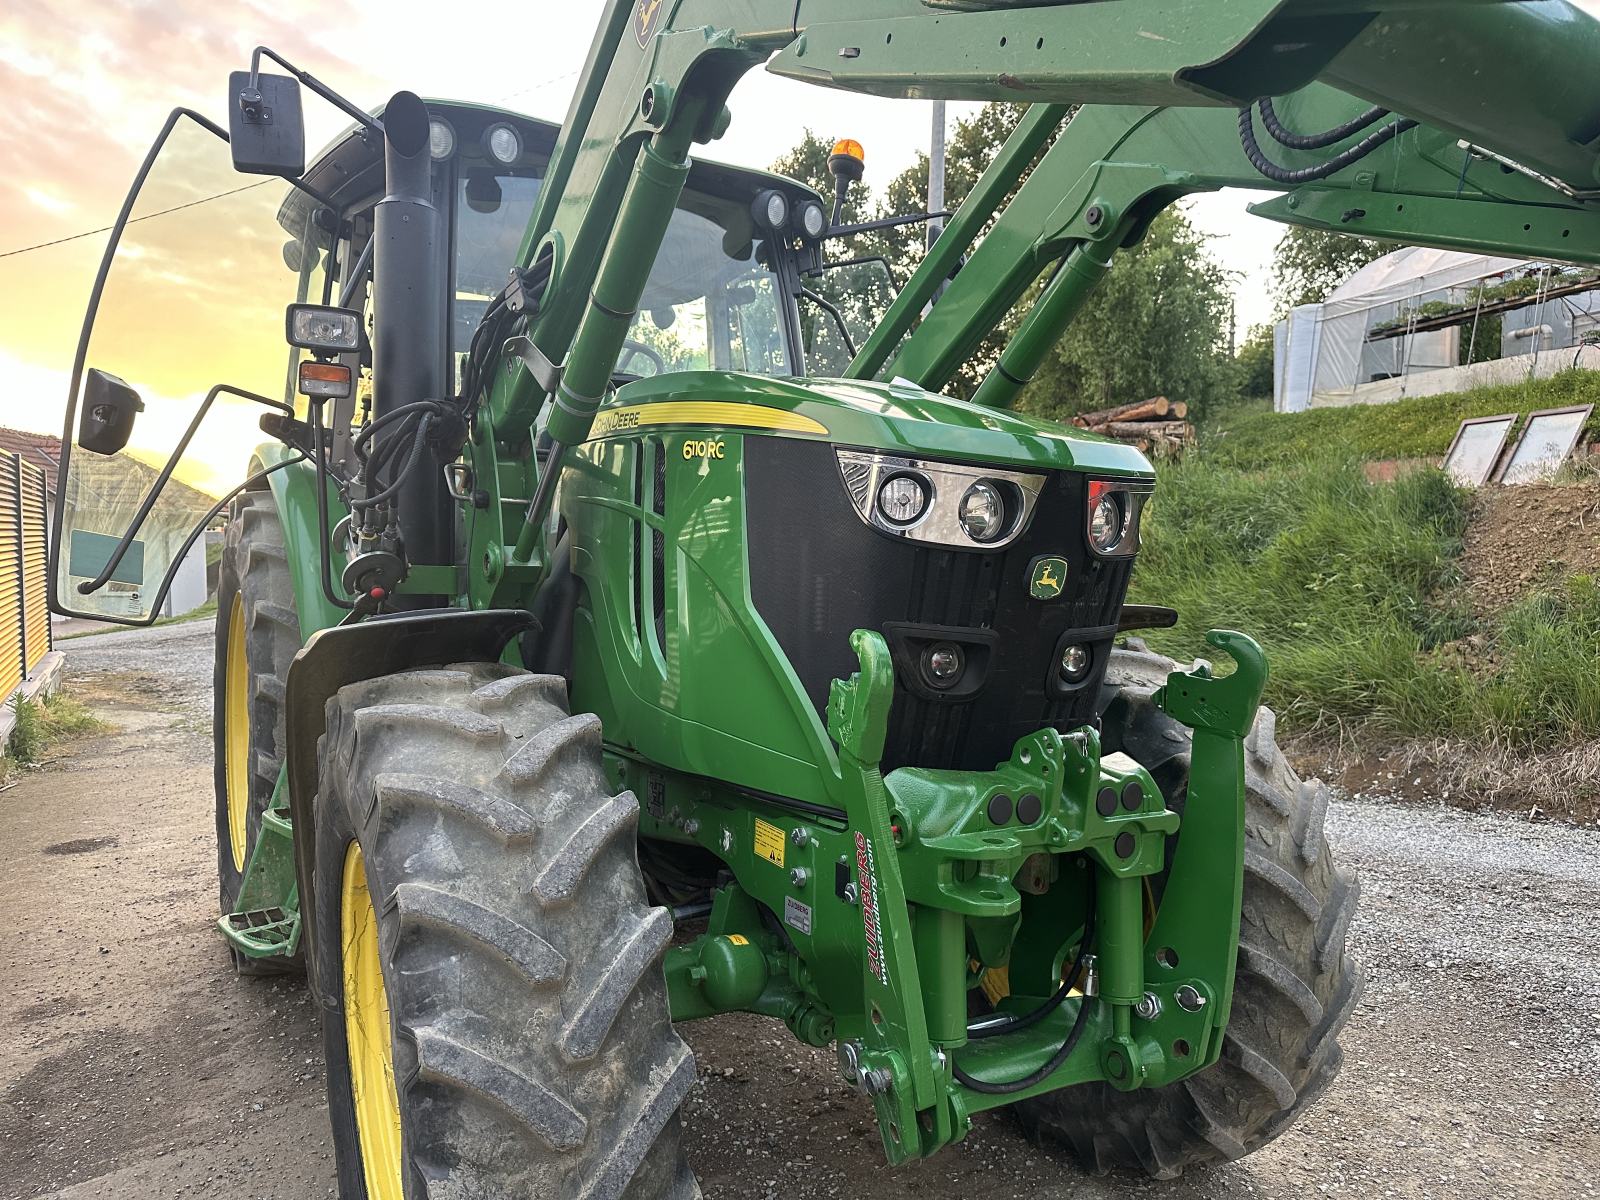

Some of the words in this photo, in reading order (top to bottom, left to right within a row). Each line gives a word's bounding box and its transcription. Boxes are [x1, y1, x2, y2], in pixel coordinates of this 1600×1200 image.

[611, 411, 640, 429] DEERE
[855, 831, 881, 981] ZUIDBERG
[866, 838, 888, 986] www.zuidberg.com
